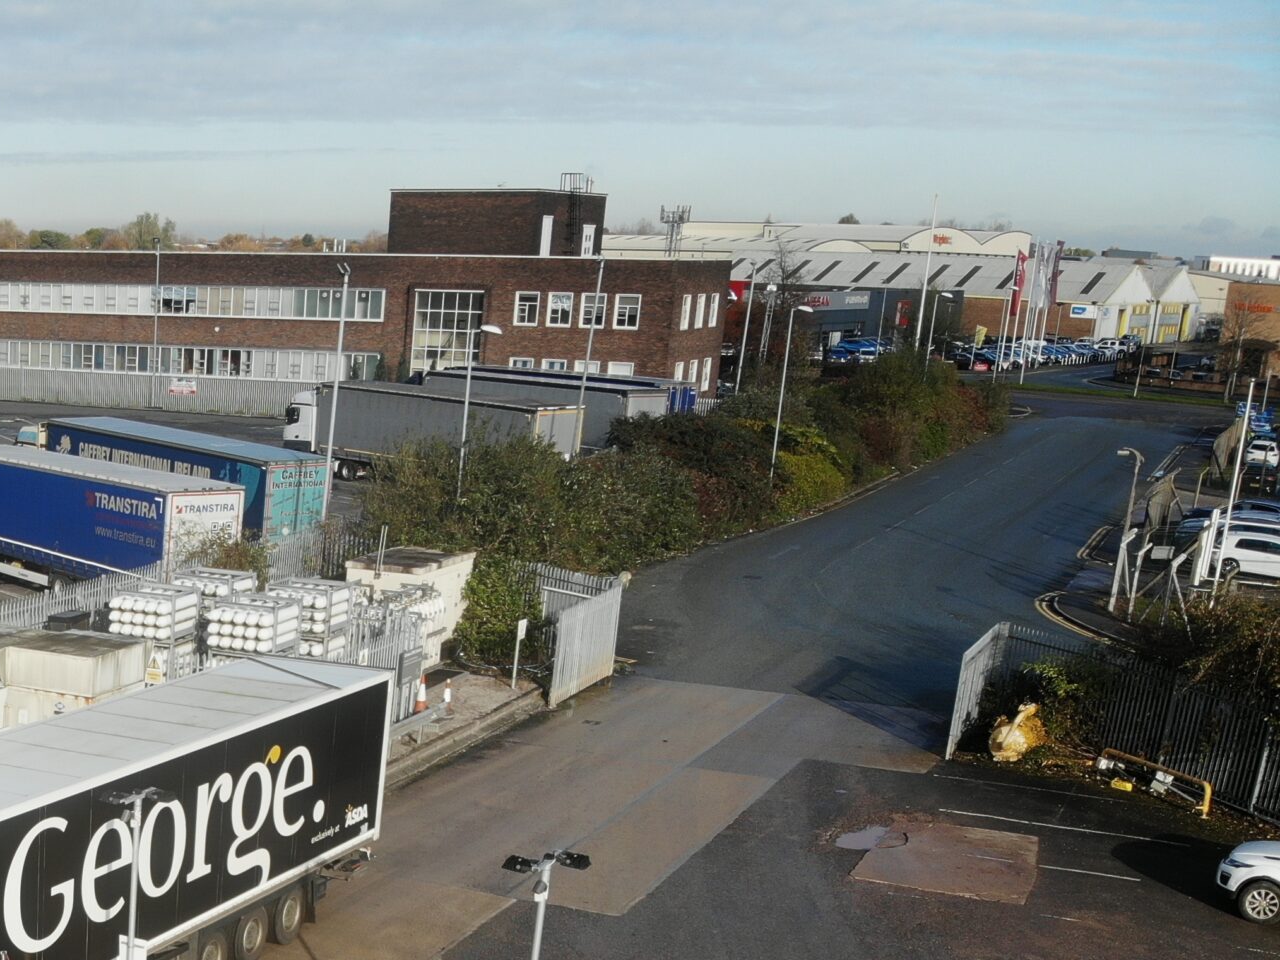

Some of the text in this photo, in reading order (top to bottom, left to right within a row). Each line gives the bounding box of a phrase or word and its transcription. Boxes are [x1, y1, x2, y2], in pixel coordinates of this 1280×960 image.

[79, 442, 211, 479] CAFFREY INTERNATIONAL IRELAND
[281, 470, 320, 480] CAFFREY
[95, 492, 157, 520] TRANSTIRA
[184, 503, 235, 514] TRANSTIRA
[95, 525, 156, 548] www.transtira.eu
[345, 804, 368, 828] ASDA
